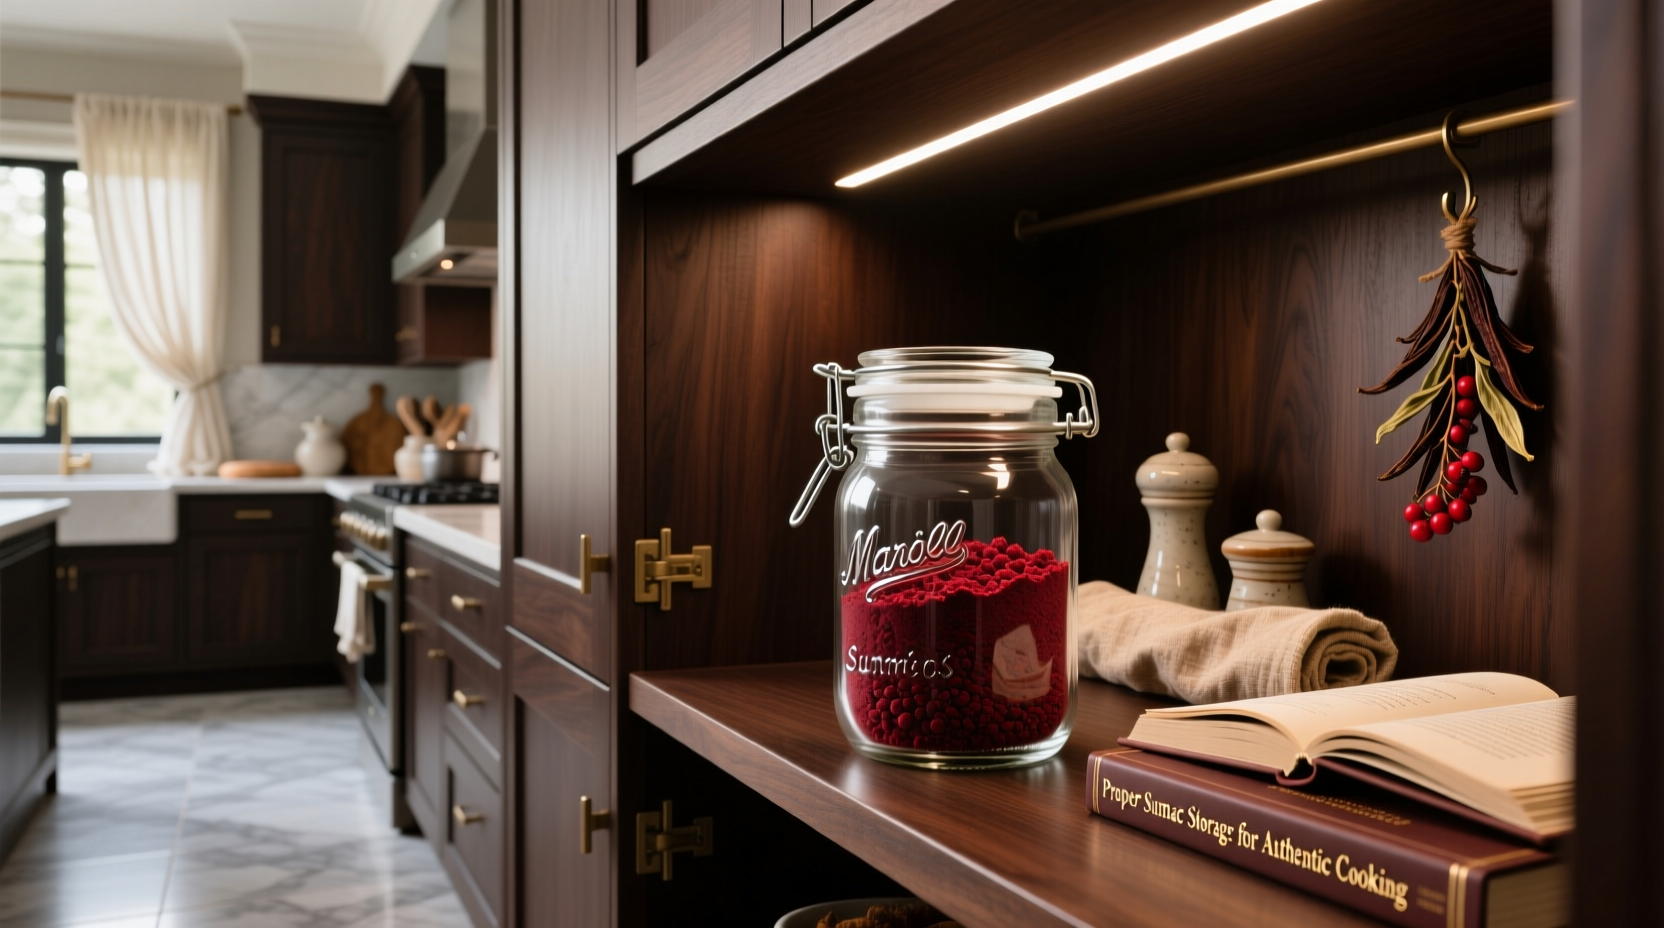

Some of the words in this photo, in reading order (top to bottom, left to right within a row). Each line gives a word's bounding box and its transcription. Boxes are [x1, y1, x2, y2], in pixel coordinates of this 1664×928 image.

[1103, 778, 1142, 810] Proper
[1143, 791, 1185, 824] Sumac
[1237, 821, 1259, 851] for
[1335, 854, 1409, 912] Cooking
